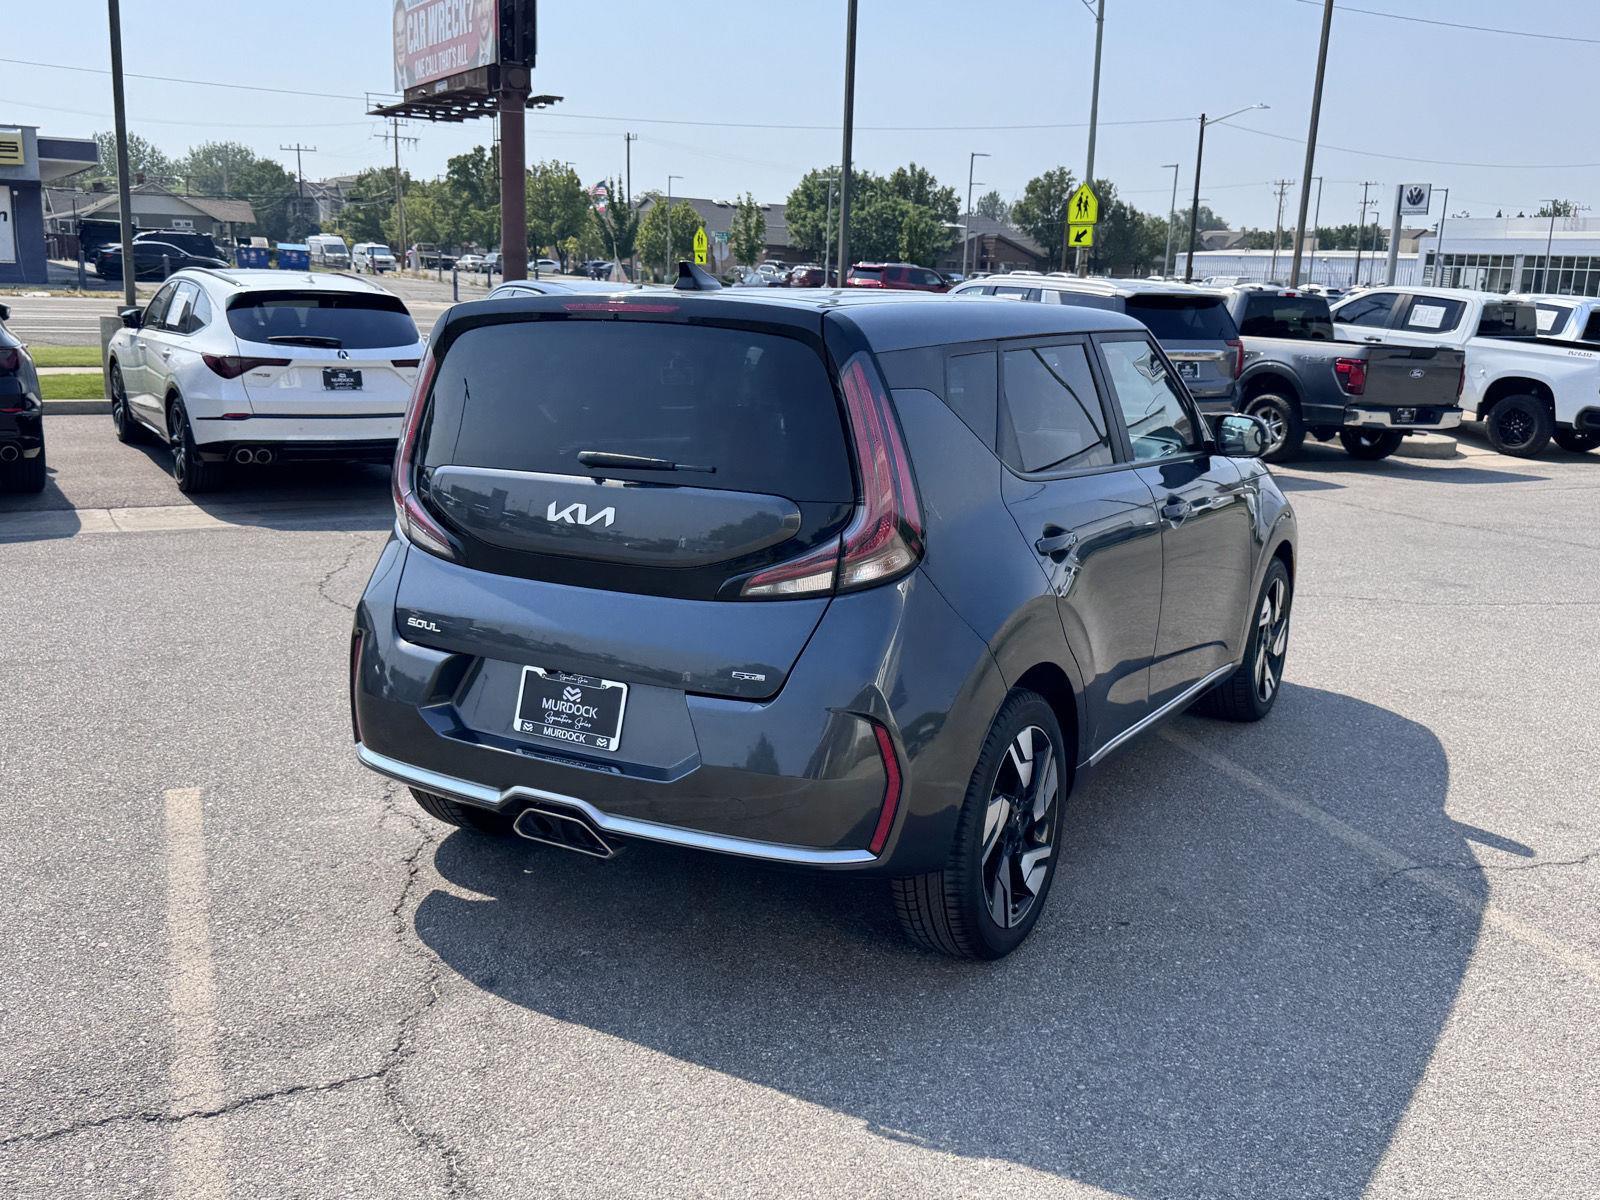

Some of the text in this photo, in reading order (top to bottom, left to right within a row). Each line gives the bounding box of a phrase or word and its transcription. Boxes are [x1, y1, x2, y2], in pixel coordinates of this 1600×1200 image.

[407, 0, 474, 55] CAR WRECK?
[425, 52, 438, 77] CALL
[457, 43, 469, 66] ALL
[547, 500, 616, 528] KIA
[407, 617, 441, 632] SOUL
[541, 697, 598, 719] MURDOCK
[542, 726, 586, 743] MURDOCK
